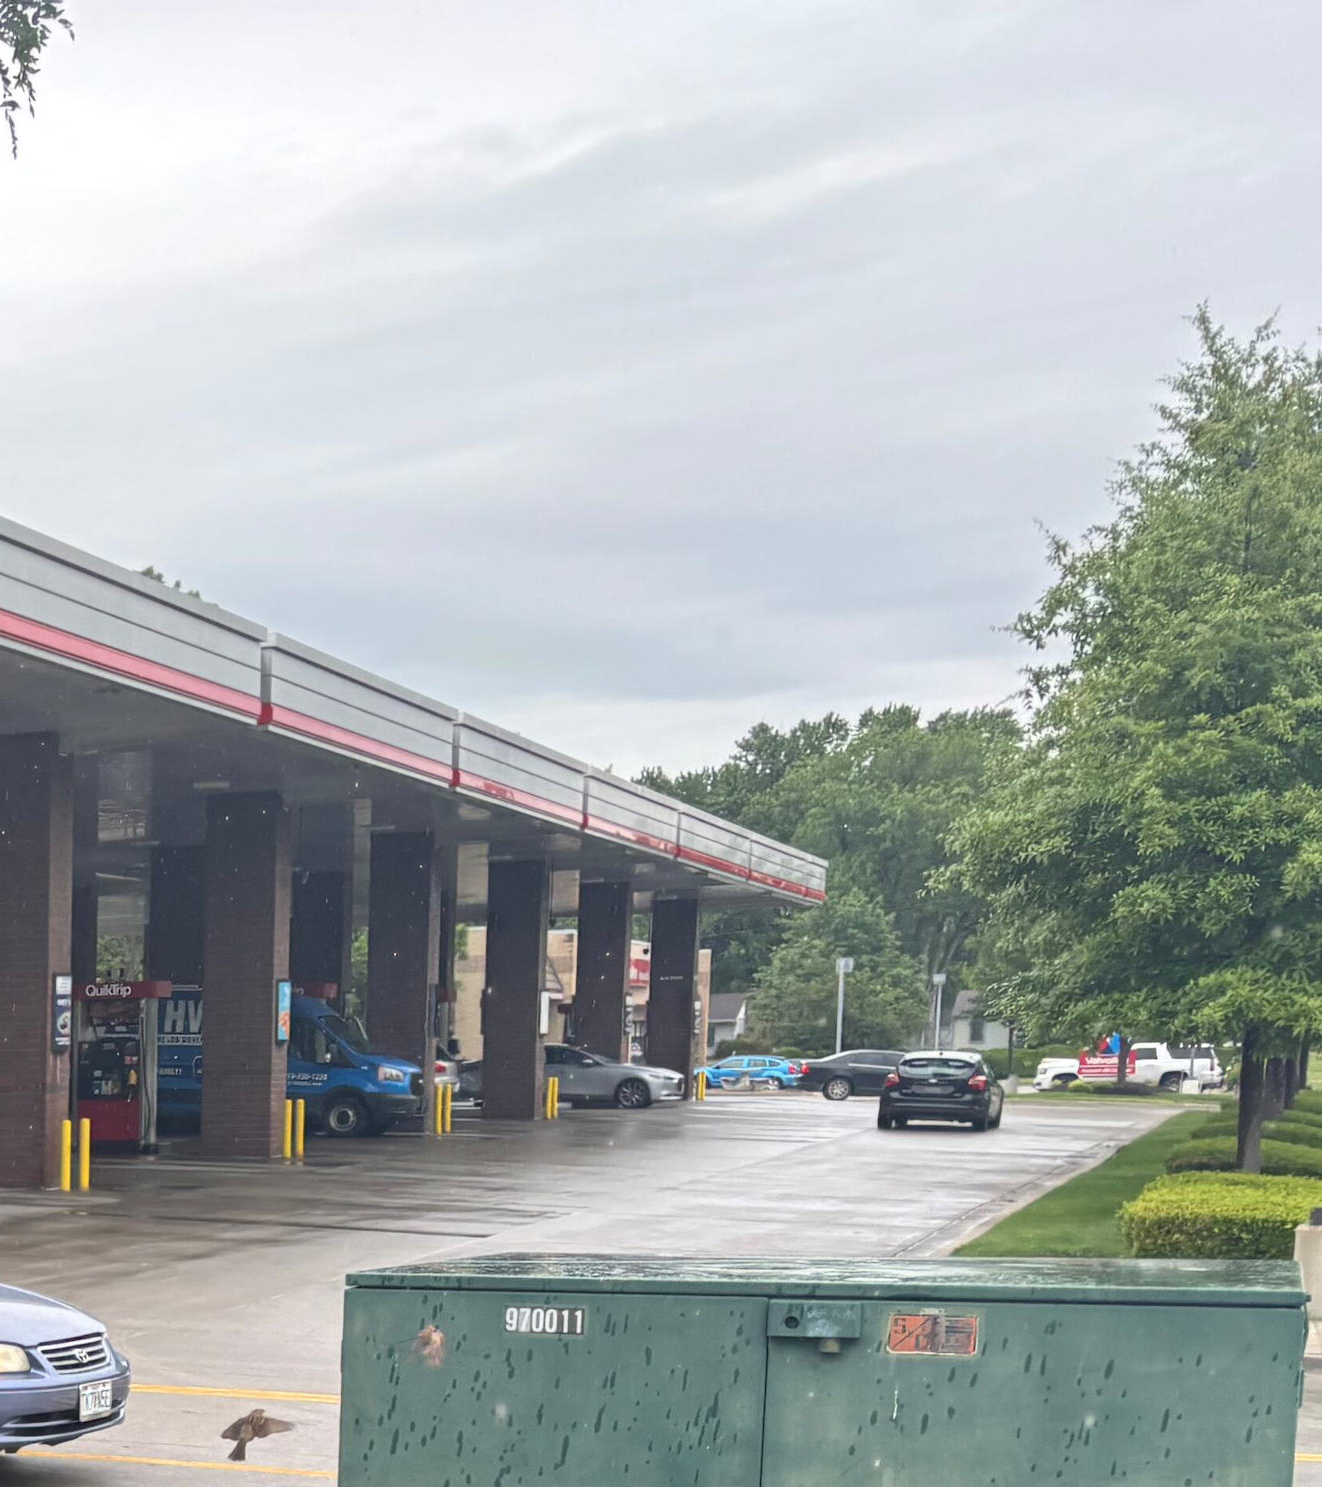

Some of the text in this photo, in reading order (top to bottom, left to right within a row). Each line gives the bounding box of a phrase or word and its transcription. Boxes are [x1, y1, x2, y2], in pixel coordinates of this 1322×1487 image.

[85, 984, 132, 997] QuikTrip
[164, 1000, 203, 1033] HV
[506, 1307, 582, 1334] 970011
